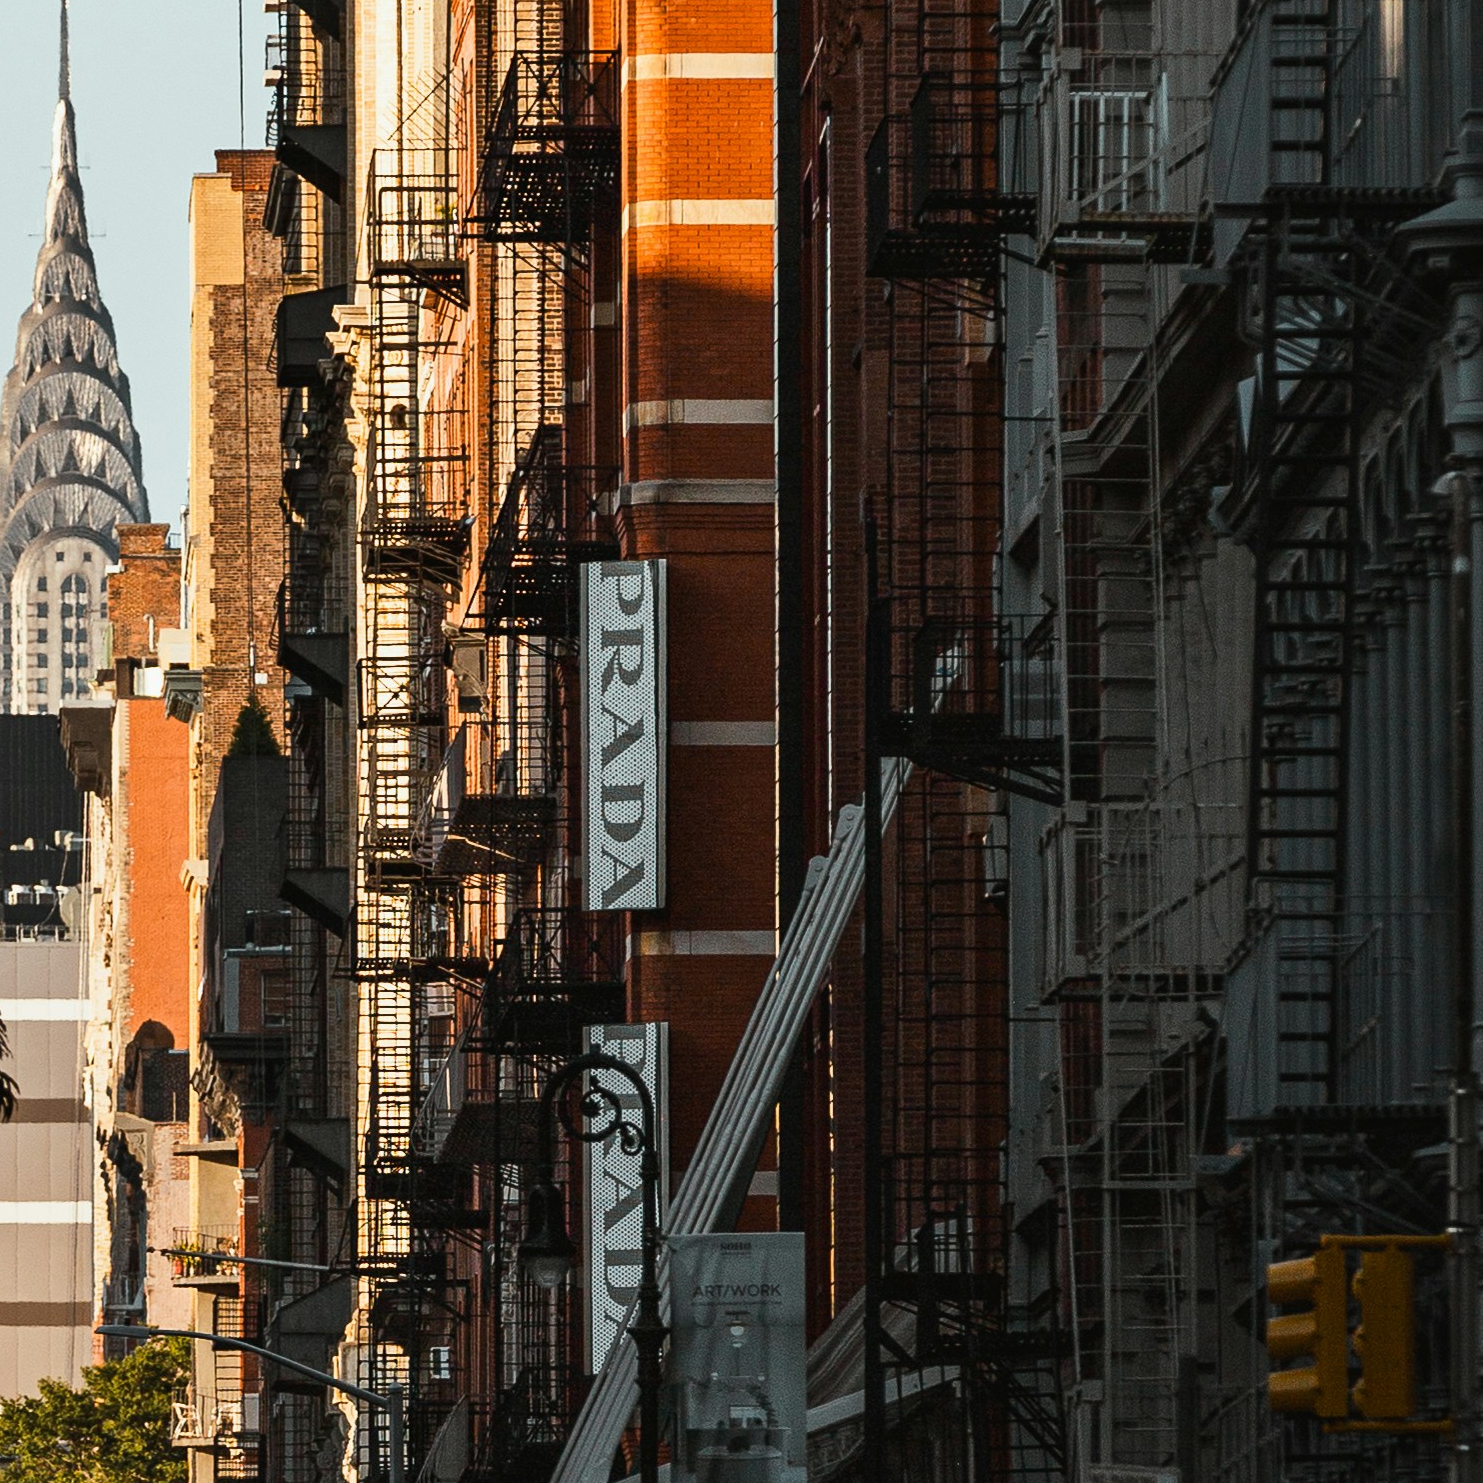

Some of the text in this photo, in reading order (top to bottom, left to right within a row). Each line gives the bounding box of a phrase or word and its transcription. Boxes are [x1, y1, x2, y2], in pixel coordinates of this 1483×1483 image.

[601, 560, 645, 909] PRADA
[604, 1023, 645, 1323] PRAD
[693, 1283, 782, 1298] ART/WORK
